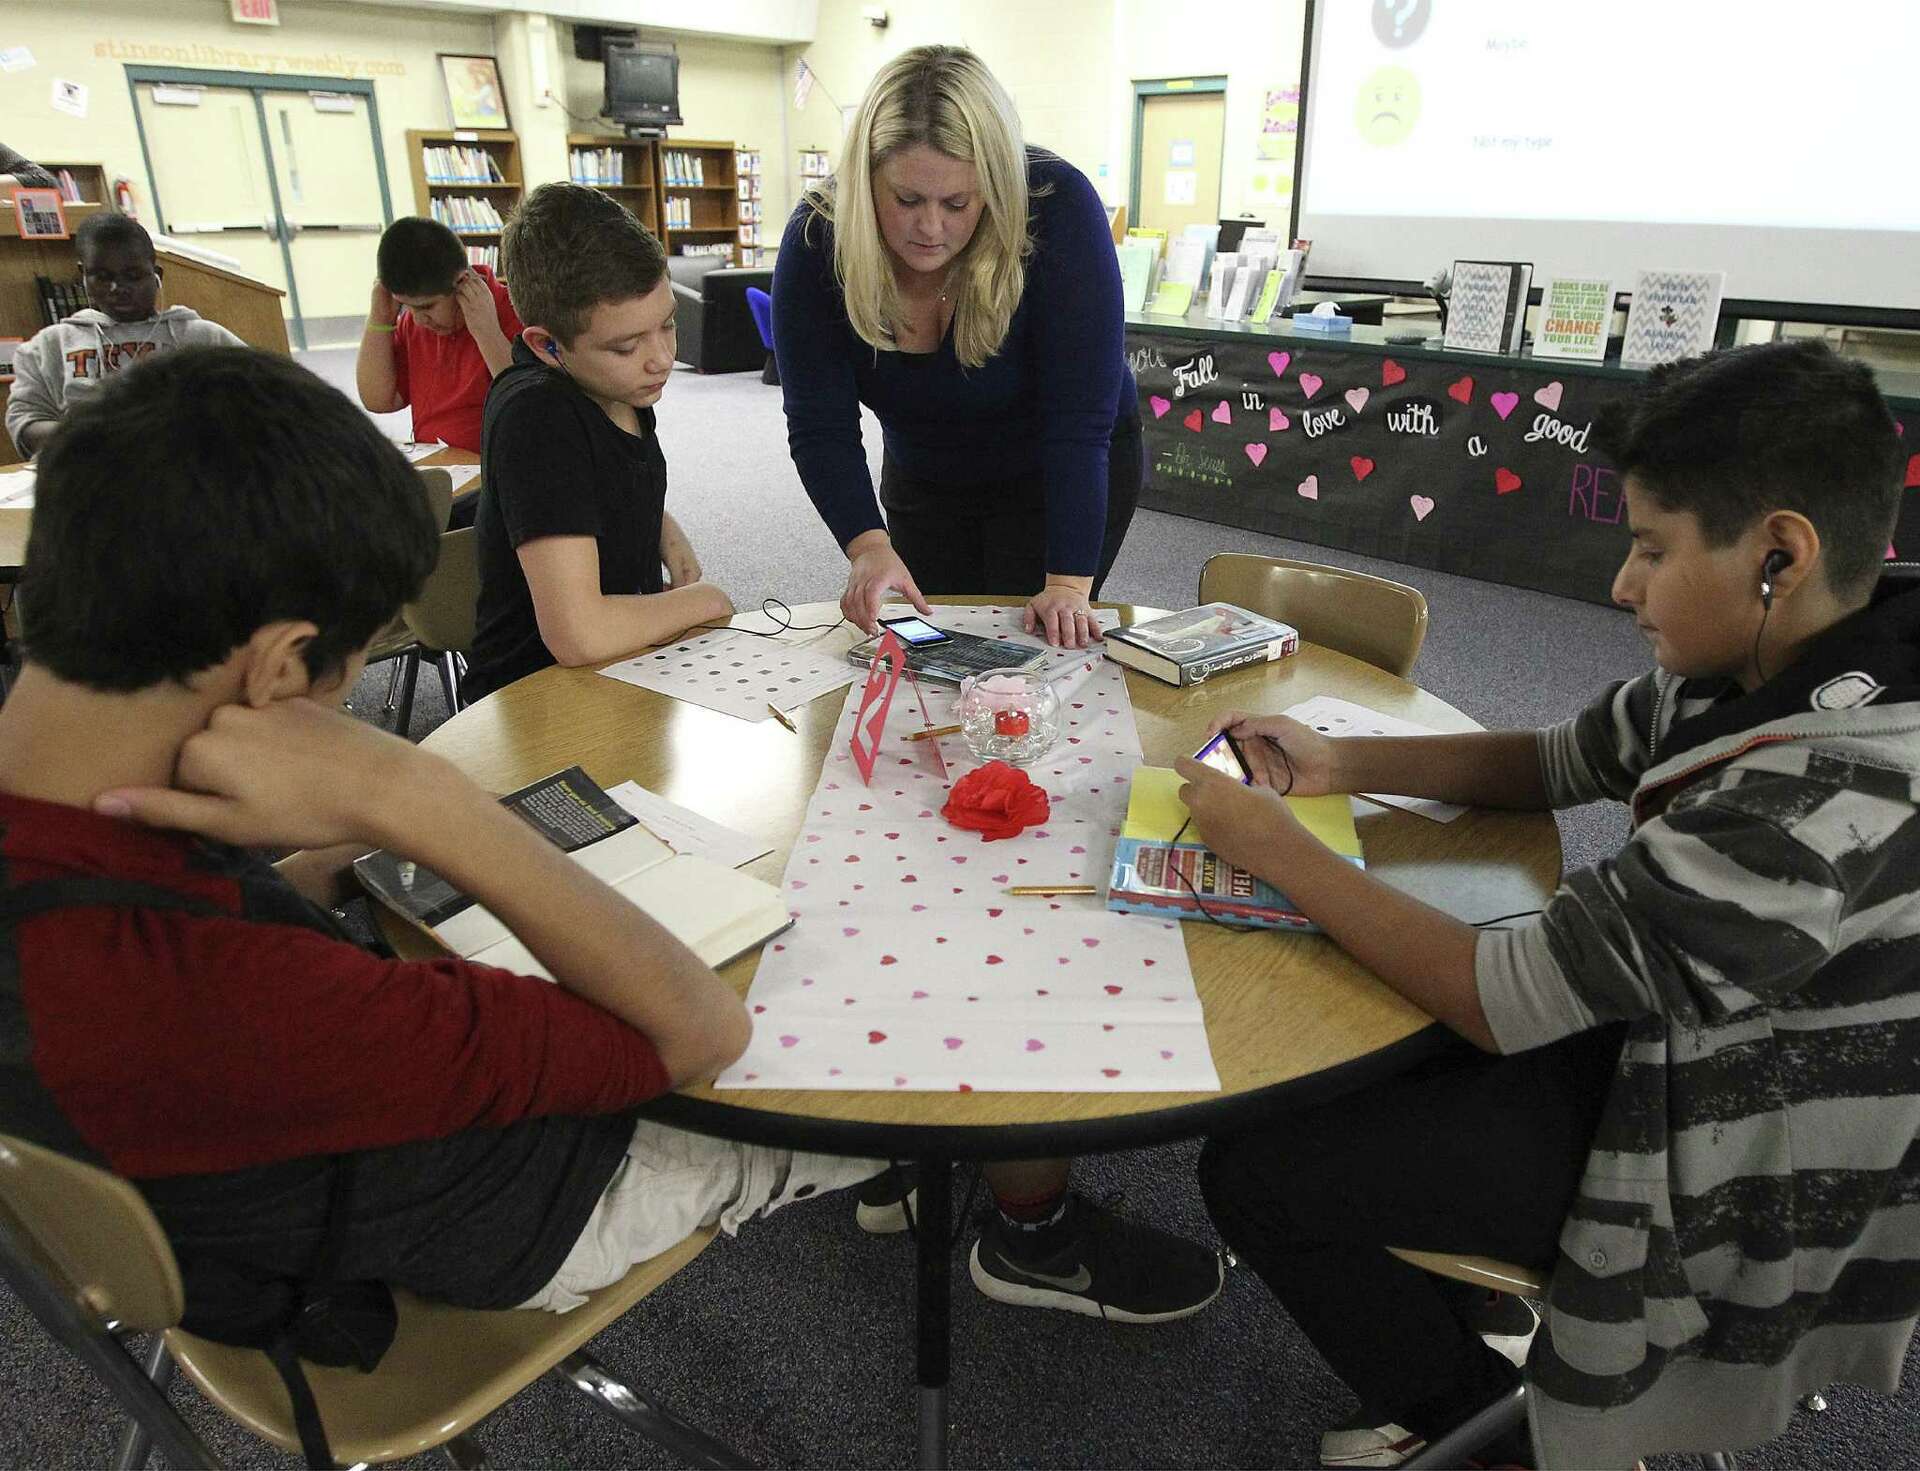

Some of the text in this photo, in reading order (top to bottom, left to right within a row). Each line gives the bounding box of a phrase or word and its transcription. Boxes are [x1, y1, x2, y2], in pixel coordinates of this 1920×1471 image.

[1545, 319, 1601, 336] CHANGE
[1543, 334, 1572, 344] YOUR
[1173, 354, 1592, 457] Fall in love with a good
